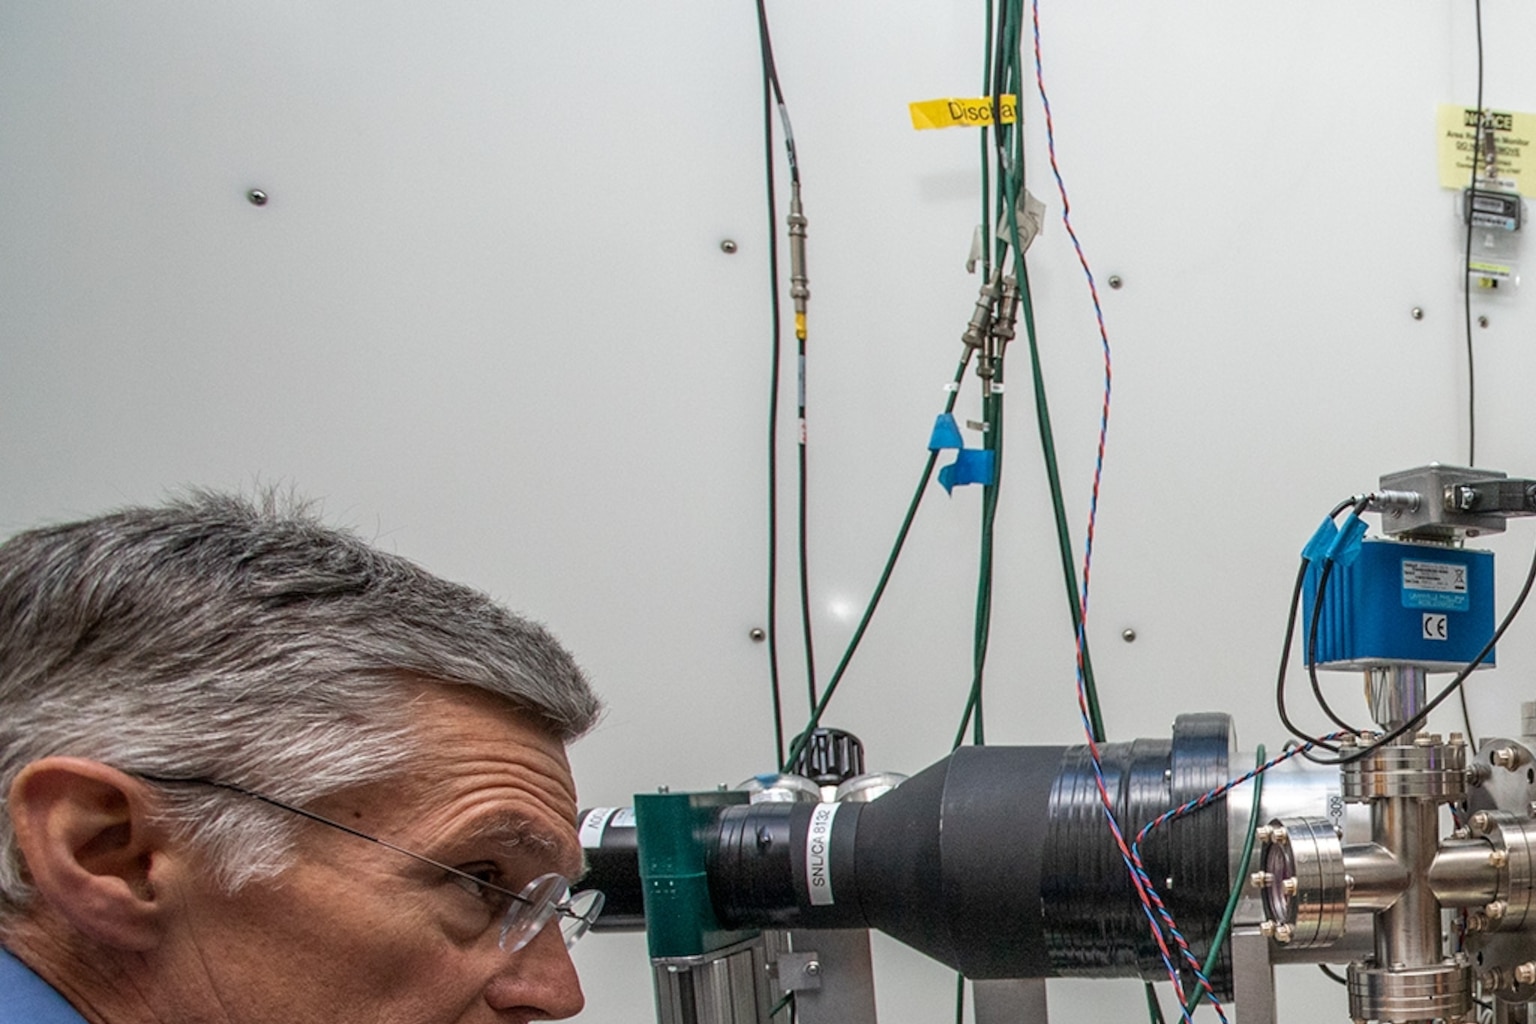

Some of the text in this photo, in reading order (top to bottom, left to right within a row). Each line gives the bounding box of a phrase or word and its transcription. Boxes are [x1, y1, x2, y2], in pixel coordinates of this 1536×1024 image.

[948, 101, 1017, 120] Disca
[811, 809, 830, 887] SNL/CA 8132
